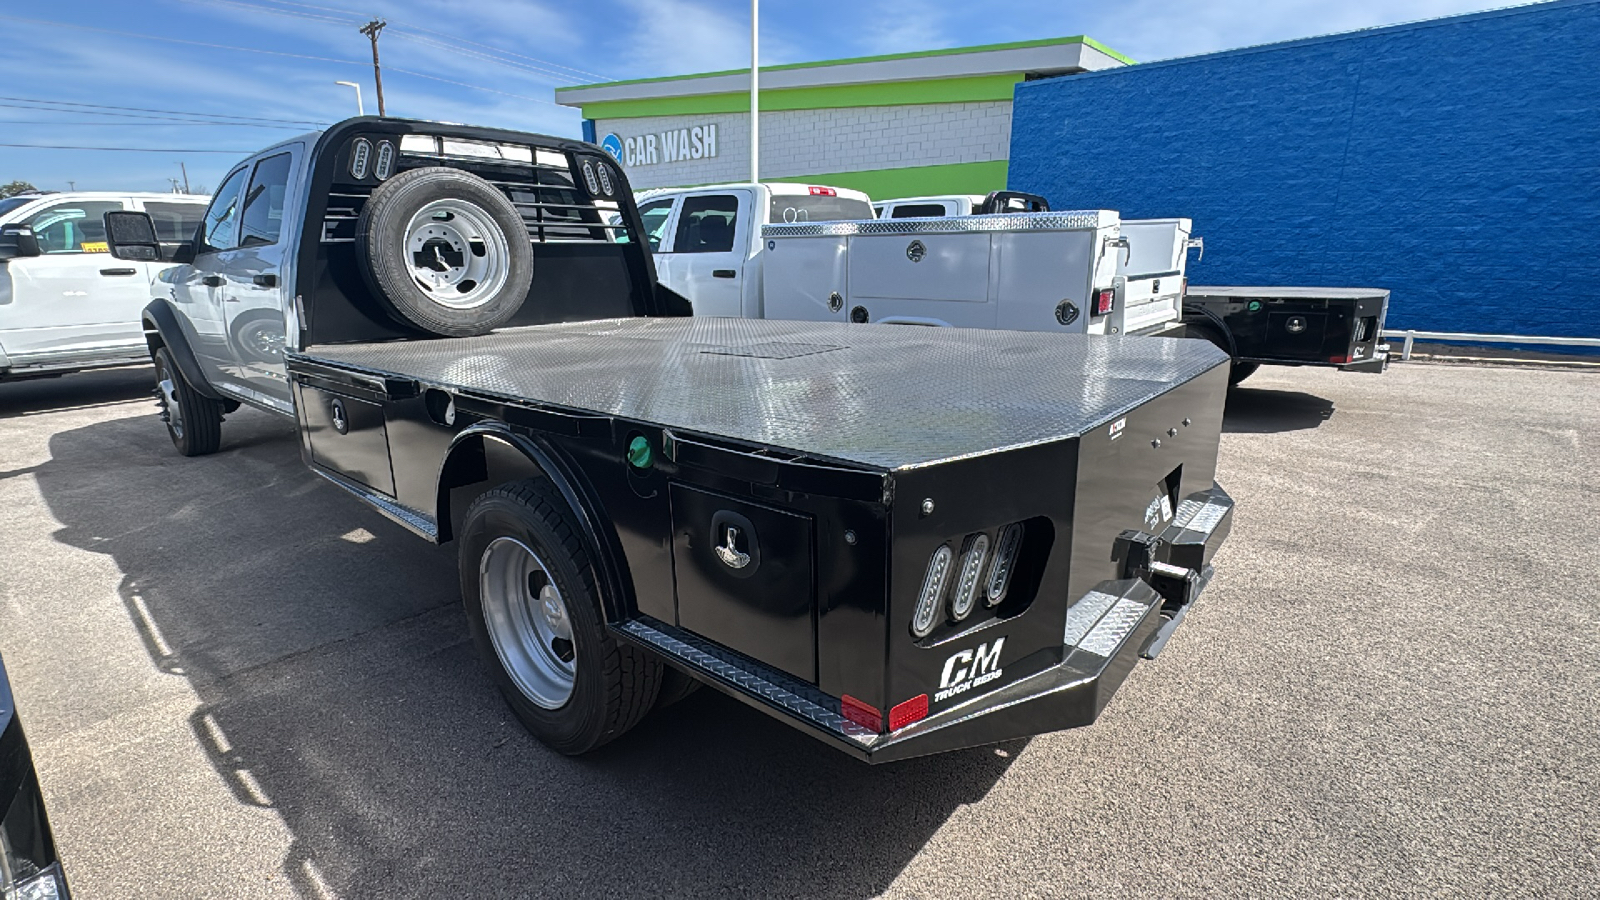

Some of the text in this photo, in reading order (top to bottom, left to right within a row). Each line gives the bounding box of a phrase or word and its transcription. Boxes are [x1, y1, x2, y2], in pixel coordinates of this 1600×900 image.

[625, 125, 716, 167] CAR WASH
[939, 637, 1006, 688] CM
[935, 669, 1002, 702] TRUCK BEDS
